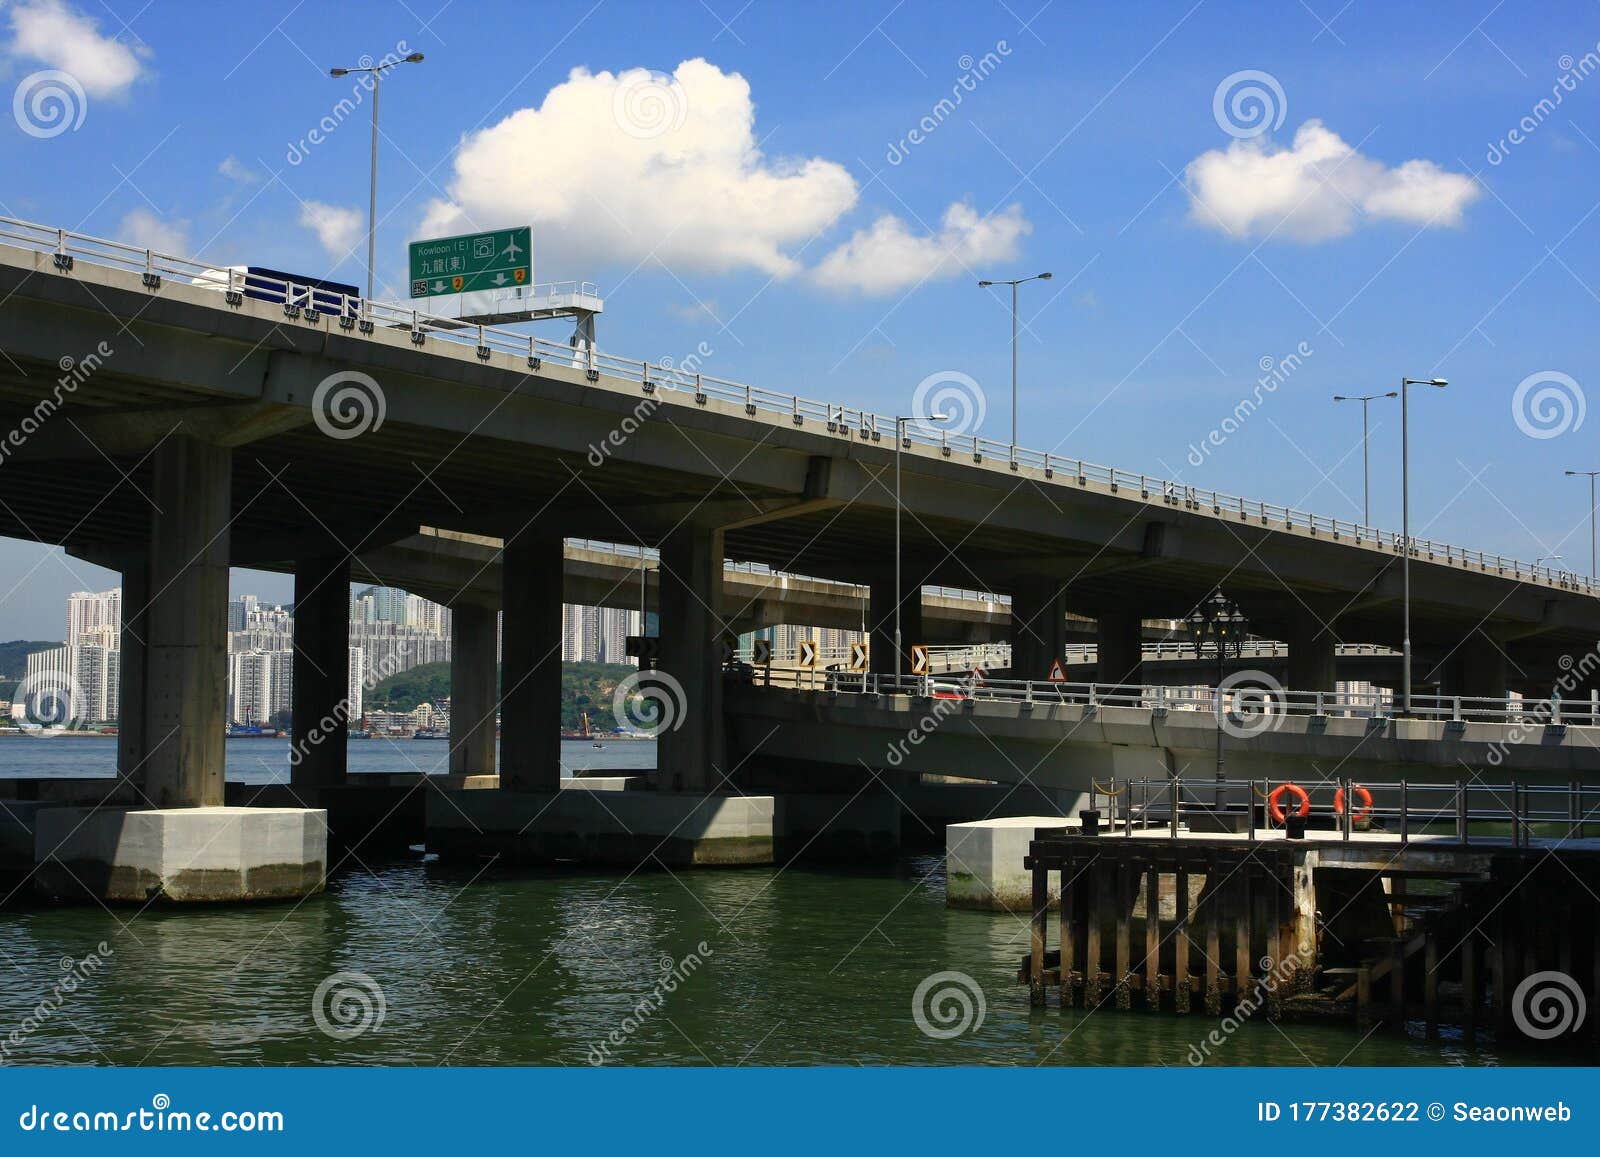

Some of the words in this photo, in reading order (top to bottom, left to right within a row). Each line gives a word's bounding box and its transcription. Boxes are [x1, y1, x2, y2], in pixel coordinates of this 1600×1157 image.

[418, 245, 451, 256] Kowloon
[454, 240, 469, 251] (E)
[420, 256, 466, 274] 九龍(東)
